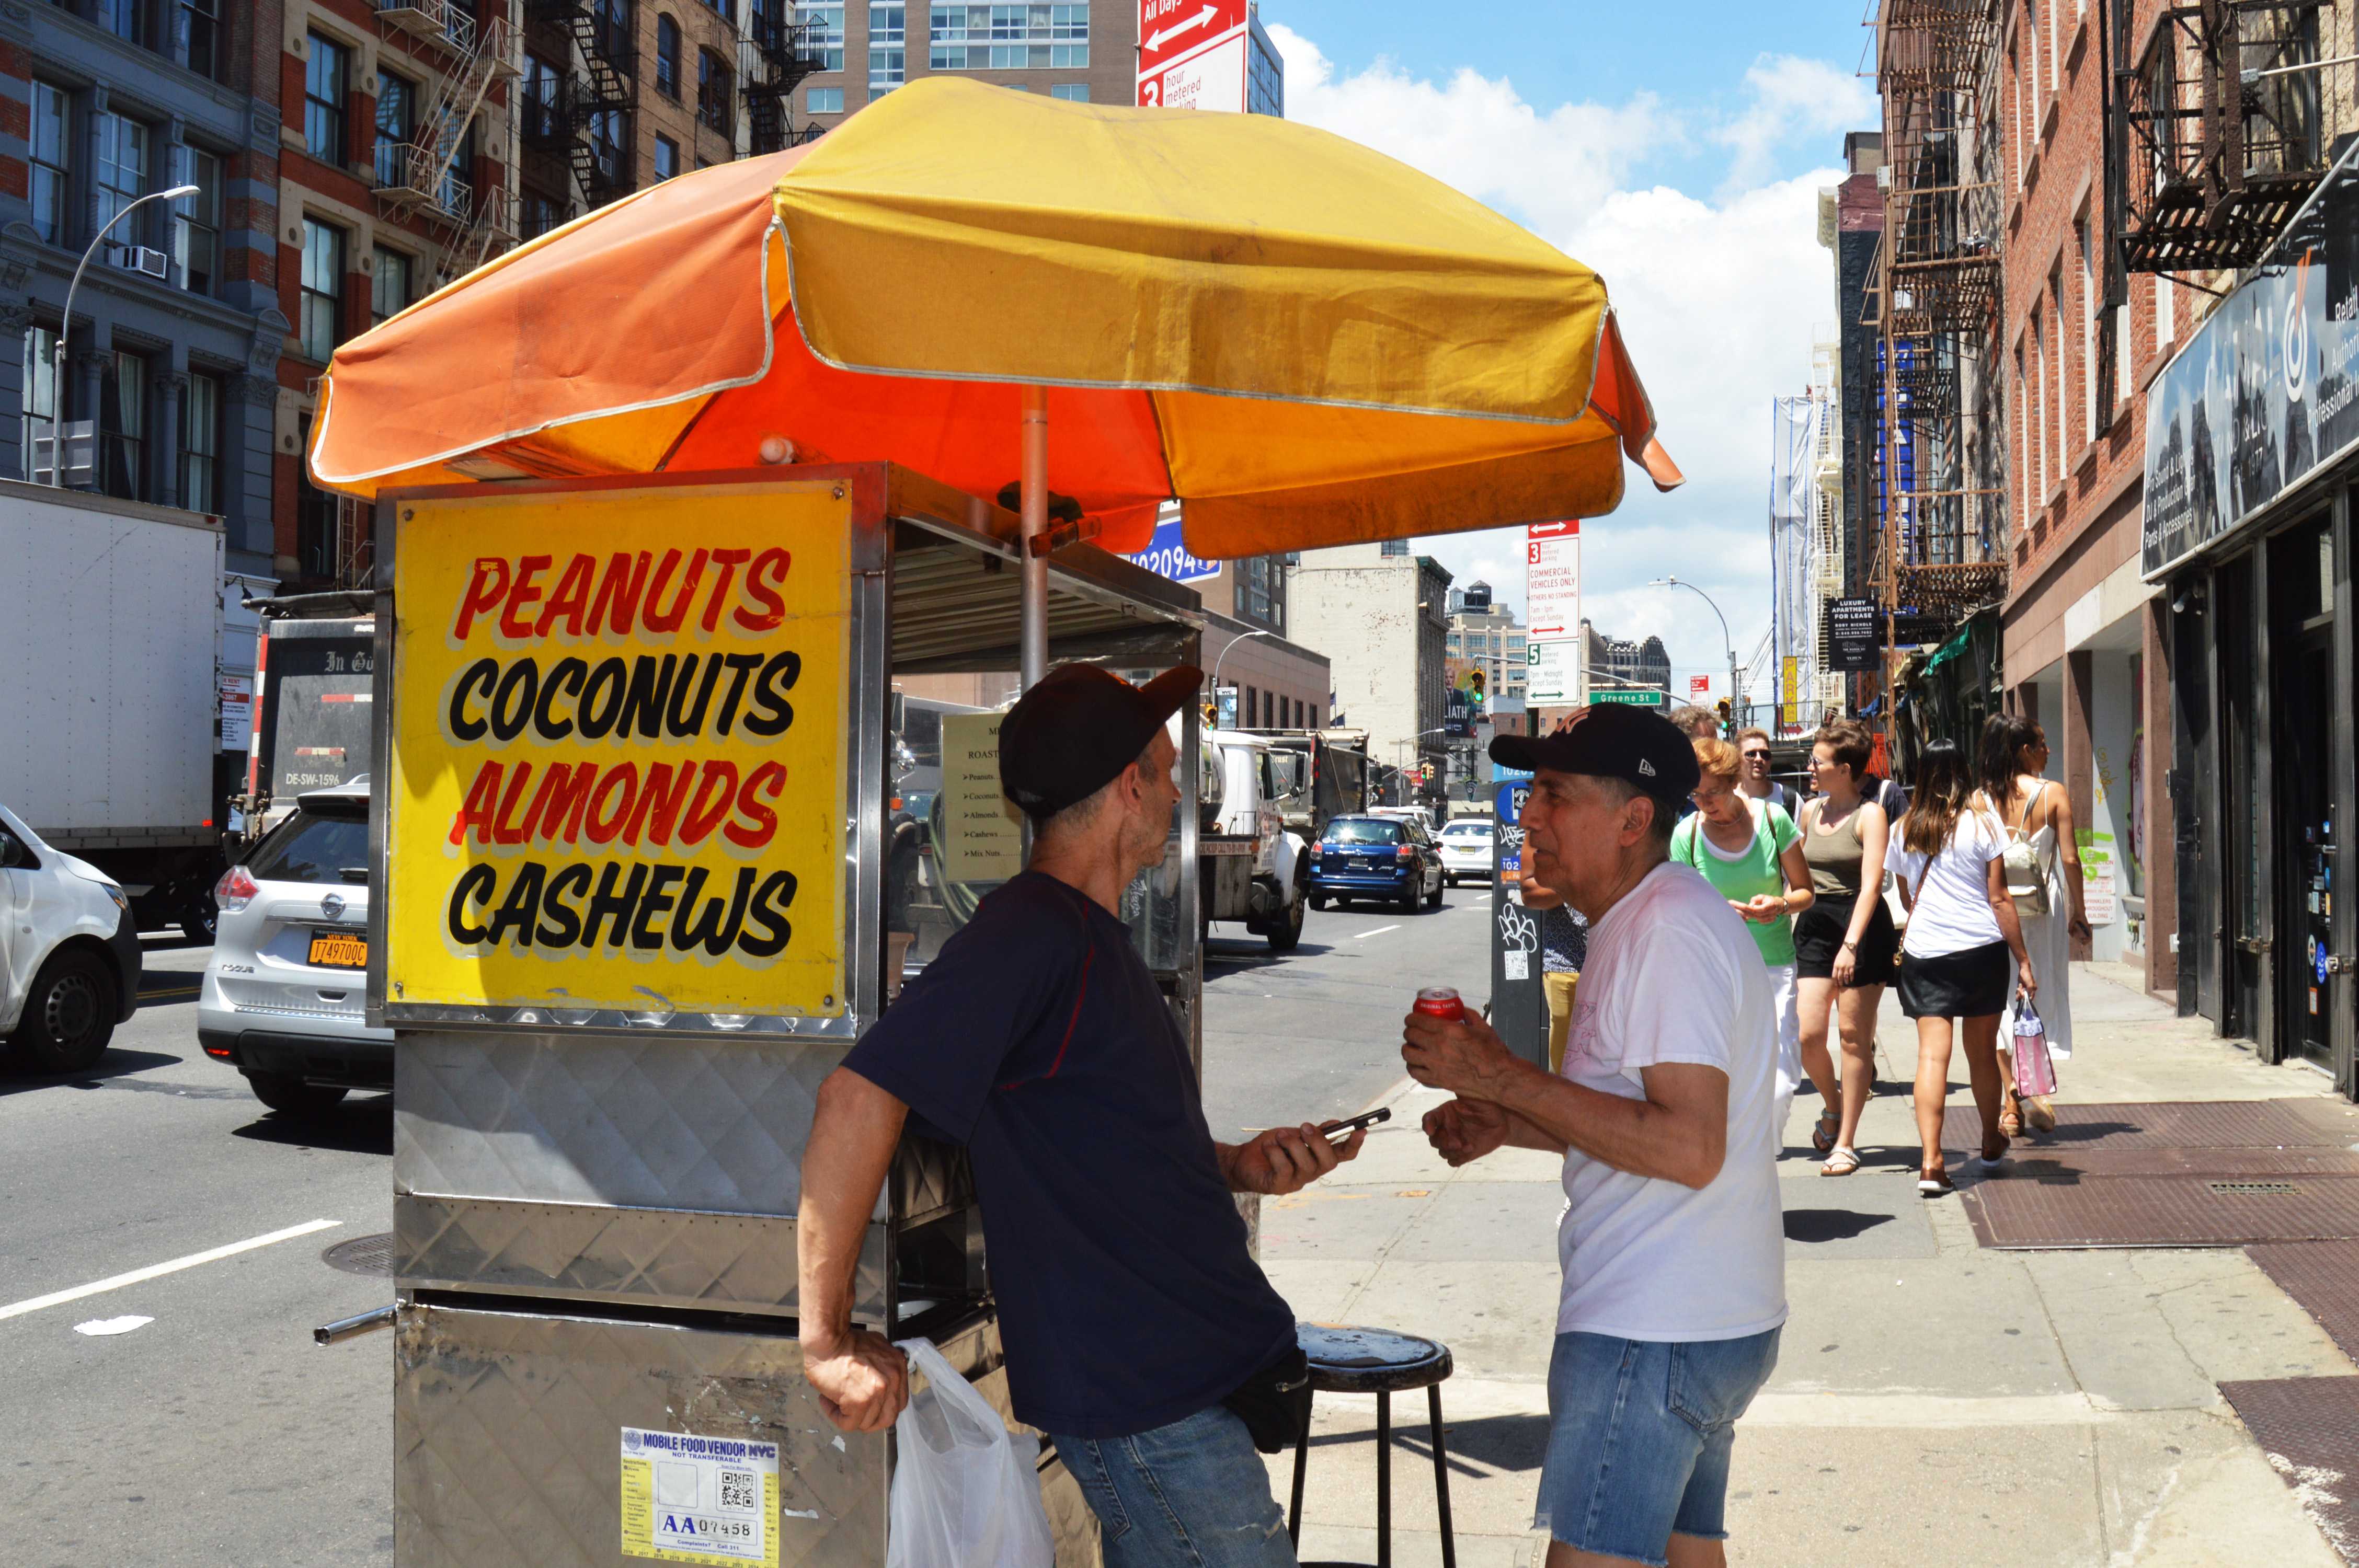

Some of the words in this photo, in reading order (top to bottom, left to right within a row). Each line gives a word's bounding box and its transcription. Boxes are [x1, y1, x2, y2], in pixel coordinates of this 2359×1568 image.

[1144, 1, 1156, 23] All
[1159, 0, 1182, 15] Days
[1166, 71, 1185, 89] hour
[1166, 76, 1201, 106] metered
[1144, 80, 1159, 107] 3
[2335, 285, 2358, 330] Retail
[2307, 373, 2353, 432] Professional
[2155, 460, 2169, 489] Sound
[2146, 500, 2153, 523] DJ
[2158, 483, 2183, 514] Production
[2184, 474, 2195, 497] Gar
[2145, 528, 2158, 550] Parts
[2162, 505, 2192, 539] Accessories
[1530, 544, 1539, 563] 3
[1530, 567, 1571, 578] COMMERCIAL
[1530, 579, 1558, 589] VEHICLES
[1560, 577, 1575, 586] ONLY
[453, 546, 792, 641] PEANUTS
[1555, 591, 1577, 599] STANDING
[324, 651, 344, 672] In
[1529, 644, 1538, 665] 5
[449, 650, 802, 742] COCONUTS
[968, 750, 1000, 759] ROAST
[285, 773, 340, 785] DE-SW-1596
[448, 759, 787, 849] ALMONDS
[1503, 861, 1519, 870] 102
[448, 861, 798, 957] CASHEWS
[315, 941, 365, 961] T749700C
[644, 1433, 678, 1450] MOBILE
[681, 1437, 706, 1453] FOOD
[707, 1440, 746, 1457] VENDOR
[748, 1444, 775, 1459] NYC
[689, 1454, 742, 1463] TRANSFERABLE
[662, 1514, 697, 1535] AA
[699, 1519, 750, 1536] 07458
